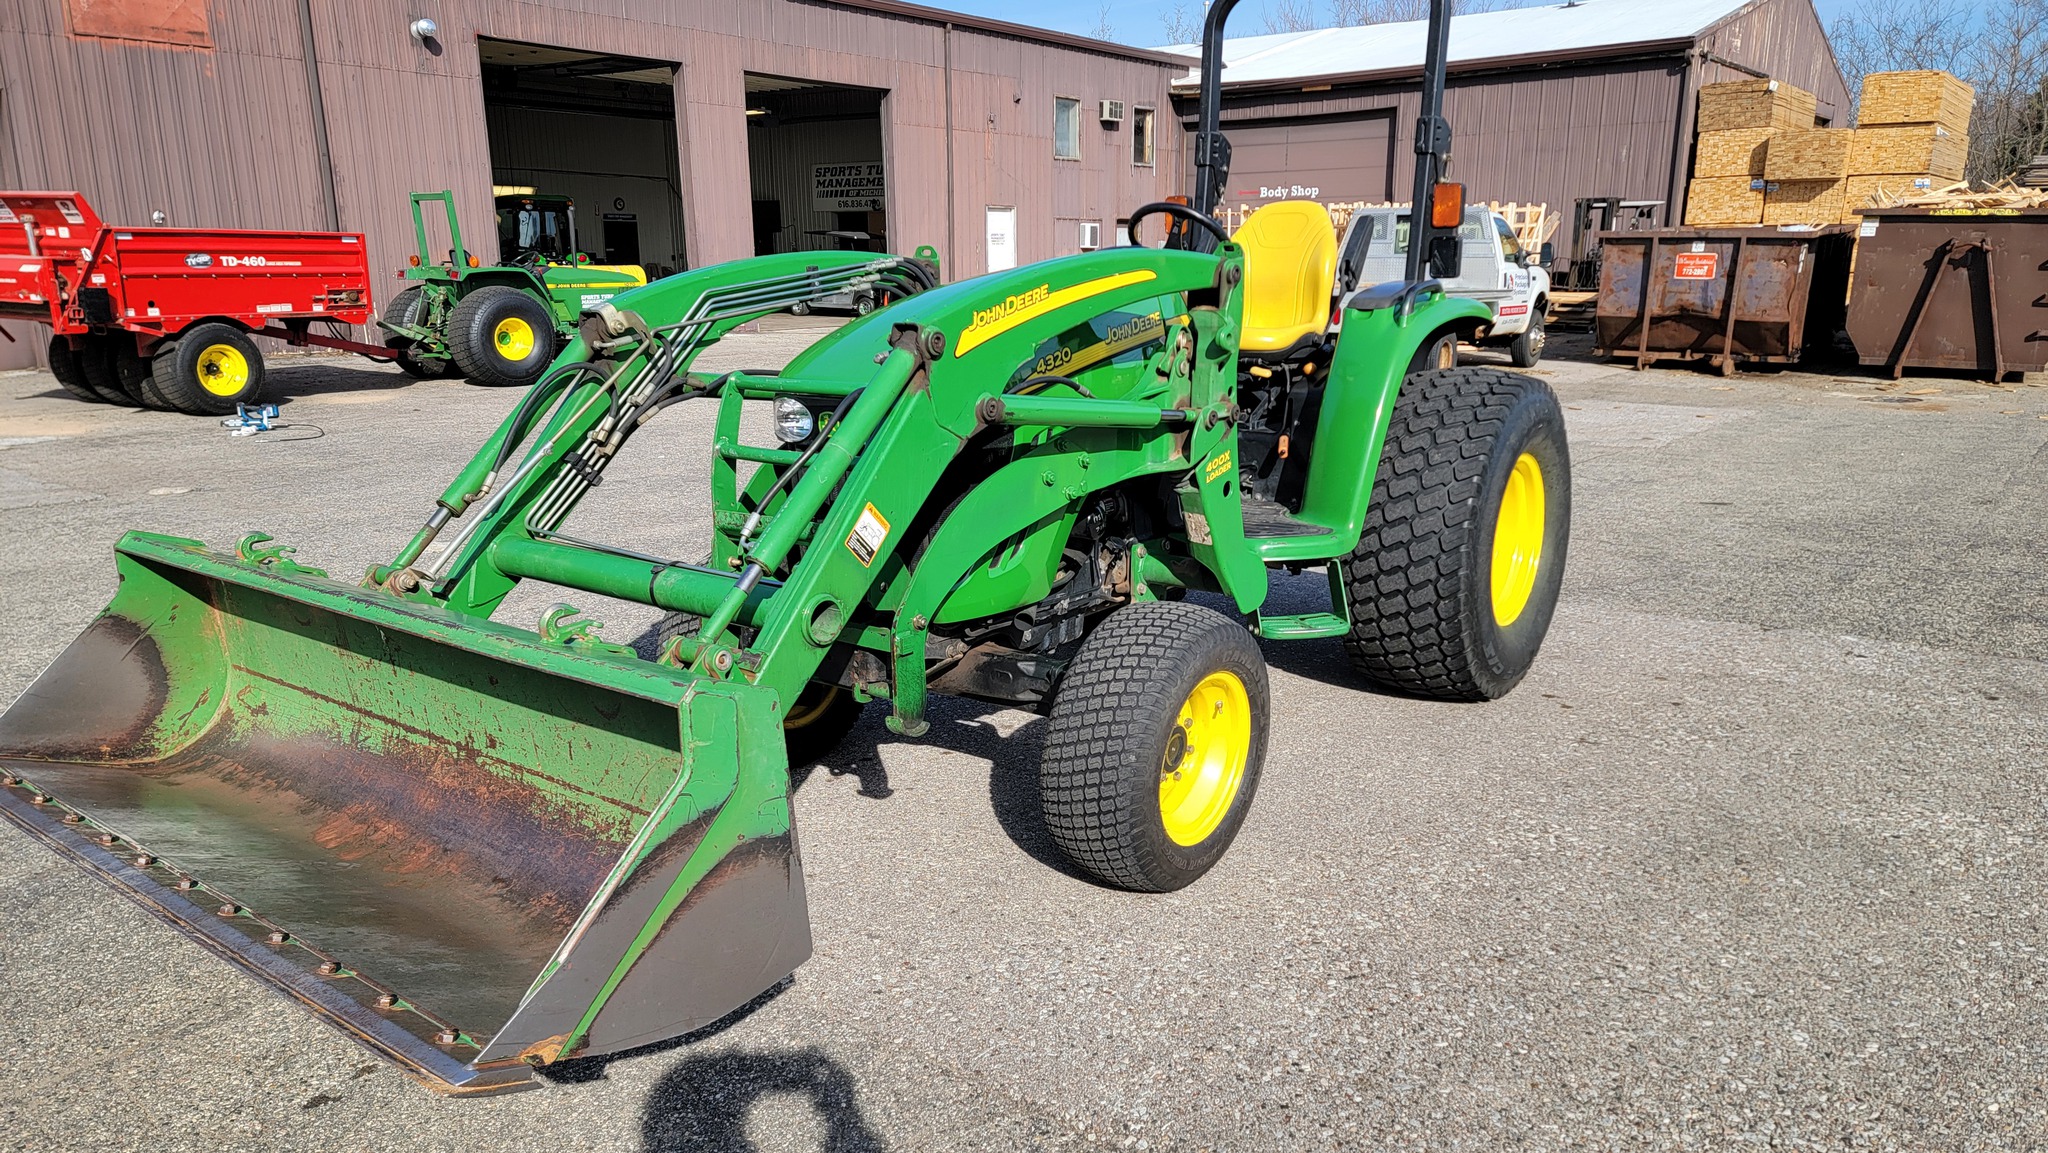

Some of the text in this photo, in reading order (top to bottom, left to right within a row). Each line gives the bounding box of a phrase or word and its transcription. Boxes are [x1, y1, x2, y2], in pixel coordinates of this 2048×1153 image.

[815, 165, 863, 178] SPORTS
[815, 177, 884, 189] MANAGEME
[848, 189, 859, 197] OF
[1259, 184, 1320, 200] Body Shop
[837, 199, 881, 209] 616.836.470
[219, 255, 266, 267] TD-460
[968, 283, 1050, 332] JOHN DEERE
[1105, 311, 1162, 345] JOHN DEERE
[1036, 346, 1073, 375] 4320
[1205, 449, 1231, 473] 400X
[1205, 461, 1232, 485] LOADER
